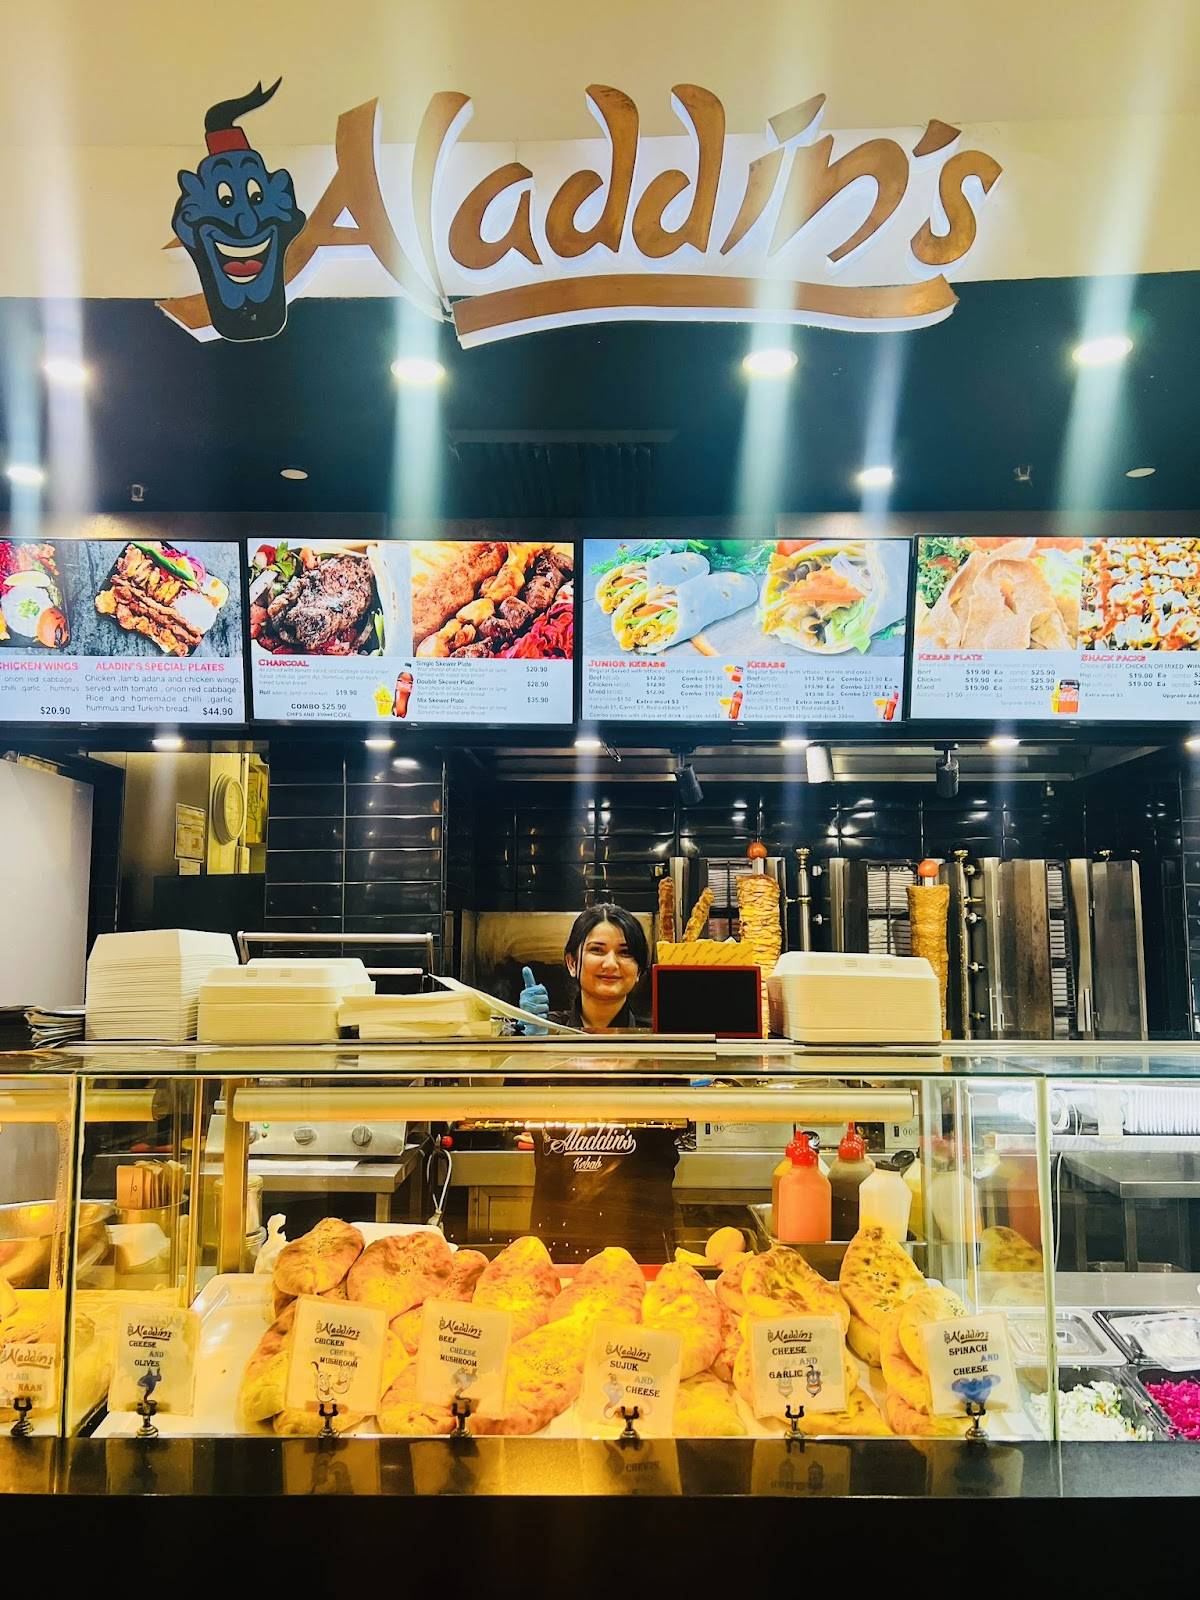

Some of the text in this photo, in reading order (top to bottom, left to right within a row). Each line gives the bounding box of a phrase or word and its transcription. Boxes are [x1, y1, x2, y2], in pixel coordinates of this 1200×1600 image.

[280, 83, 1003, 300] Aladdin's
[45, 662, 79, 671] WINGS
[145, 662, 185, 672] SPECIAL
[188, 663, 225, 672] PLATES
[257, 659, 310, 667] CHARCOAL
[588, 660, 626, 668] JUNIOR
[1031, 669, 1056, 677] $25.90
[168, 675, 182, 683] and
[184, 675, 214, 684] chicken
[1030, 677, 1055, 685] $25.90
[113, 684, 129, 692] with
[189, 685, 202, 693] red
[203, 685, 237, 695] cabbage
[110, 694, 125, 702] and
[40, 706, 71, 716] $20.90
[119, 704, 135, 712] and
[202, 707, 234, 717] $44.90
[551, 1129, 637, 1153] Aladdin's
[573, 1155, 603, 1170] Kebab
[314, 1337, 345, 1347] CHICKEN
[438, 1334, 457, 1344] BEEF
[128, 1340, 157, 1349] CHEESE
[948, 1343, 988, 1356] SPINACH
[148, 1351, 165, 1359] AND
[449, 1346, 477, 1358] CHEESE
[772, 1345, 808, 1356] CHEESE
[319, 1356, 358, 1369] MUSHROOM
[439, 1353, 478, 1368] MUSHROOM
[799, 1357, 818, 1366] AND
[980, 1353, 999, 1363] AND
[134, 1359, 161, 1368] OLIVES
[609, 1359, 639, 1372] SUJUK
[768, 1369, 803, 1379] GARLIC
[952, 1364, 989, 1376] CHEESE
[634, 1375, 654, 1386] AND
[17, 1383, 43, 1392] NAAN
[625, 1385, 661, 1398] CHEESE
